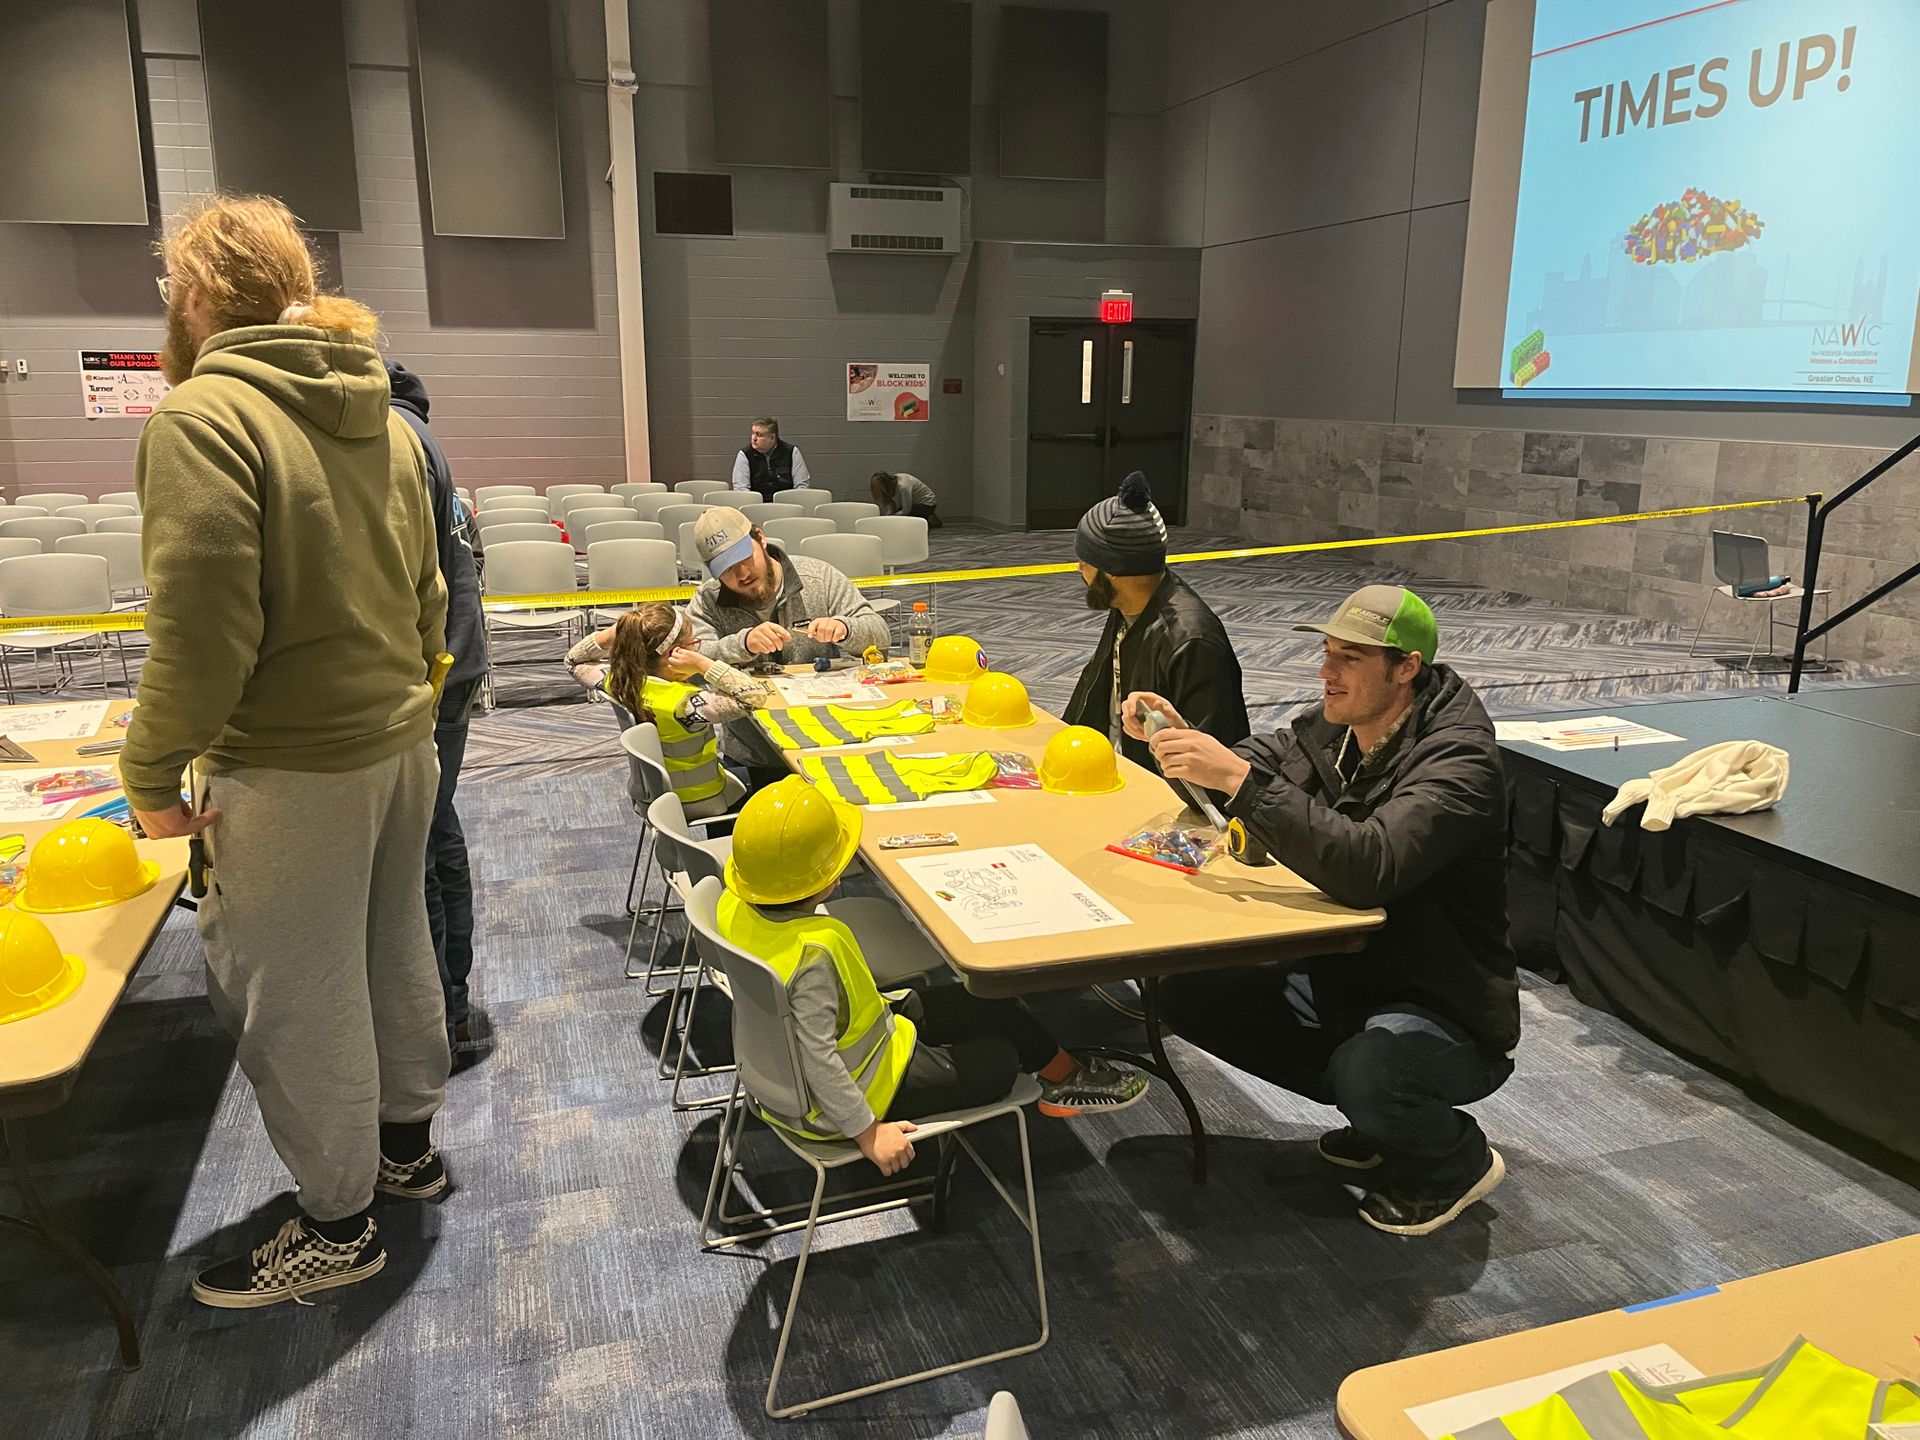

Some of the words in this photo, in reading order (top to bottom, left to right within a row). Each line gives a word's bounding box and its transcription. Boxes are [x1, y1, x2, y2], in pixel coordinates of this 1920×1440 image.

[1574, 56, 1729, 143] TIMES
[1748, 26, 1857, 108] UP!
[1107, 302, 1128, 320] EXIT
[1812, 314, 1882, 347] NAWIC
[1808, 374, 1834, 382] Greater
[1863, 375, 1874, 383] NE
